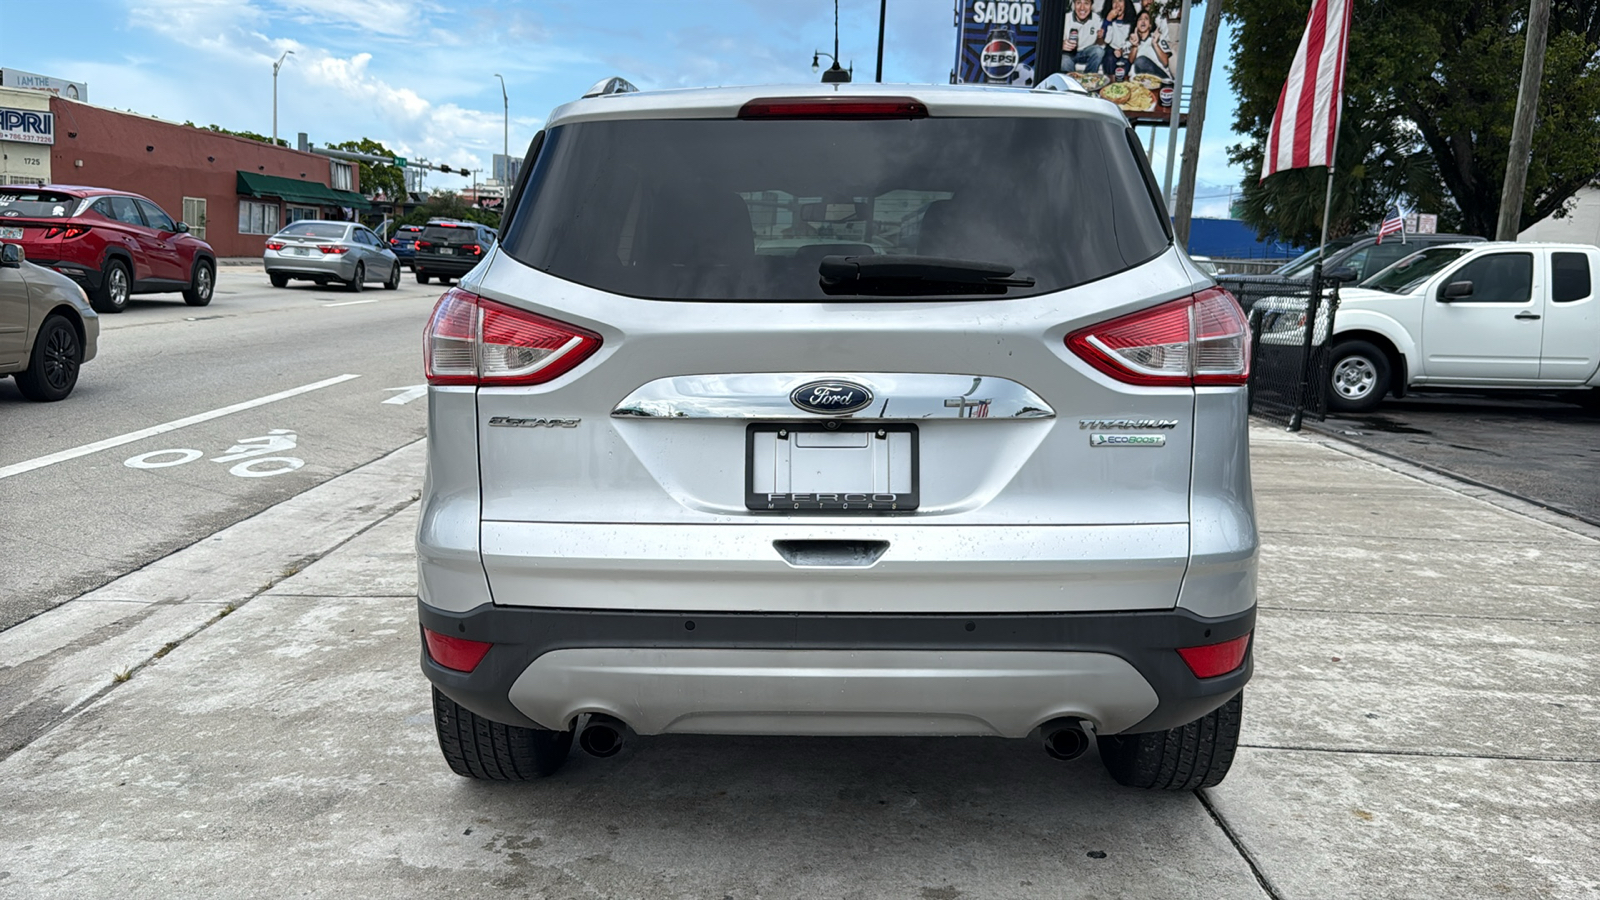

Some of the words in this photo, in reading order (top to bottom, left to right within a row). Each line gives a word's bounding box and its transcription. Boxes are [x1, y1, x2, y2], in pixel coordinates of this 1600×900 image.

[973, 1, 1035, 25] SABOR
[983, 54, 1016, 63] PEPSI
[21, 76, 33, 86] AM
[34, 77, 50, 87] THE
[9, 133, 52, 143] 786.237.7226
[24, 158, 41, 166] 1725
[809, 386, 854, 405] Ford
[488, 416, 582, 428] ESCAPE
[1078, 418, 1179, 430] TITANIUM
[767, 493, 897, 502] FERCO
